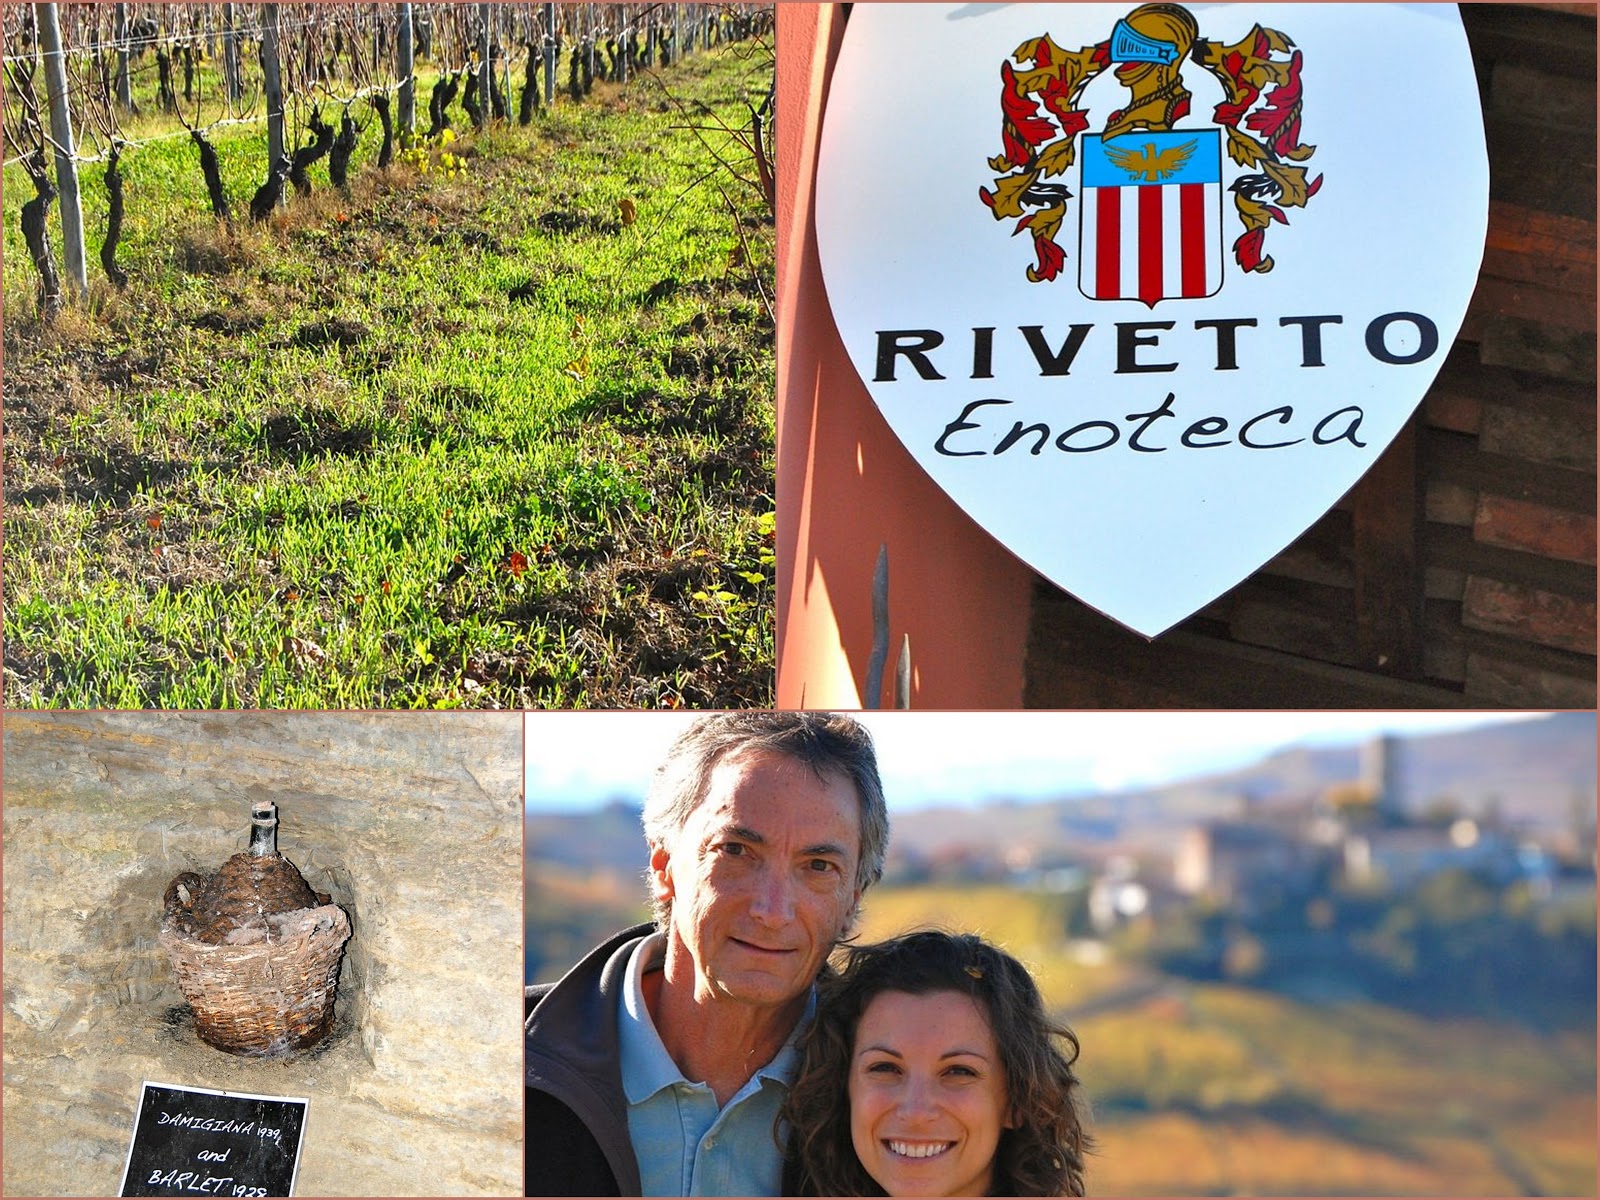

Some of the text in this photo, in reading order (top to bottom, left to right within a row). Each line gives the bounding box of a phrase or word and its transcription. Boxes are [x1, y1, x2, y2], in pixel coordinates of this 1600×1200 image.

[872, 311, 1439, 382] RIVETTO
[933, 392, 1368, 457] Enoteca
[157, 1111, 255, 1135] DAMIGIANA
[197, 1148, 231, 1162] and
[148, 1169, 233, 1192] BARLET
